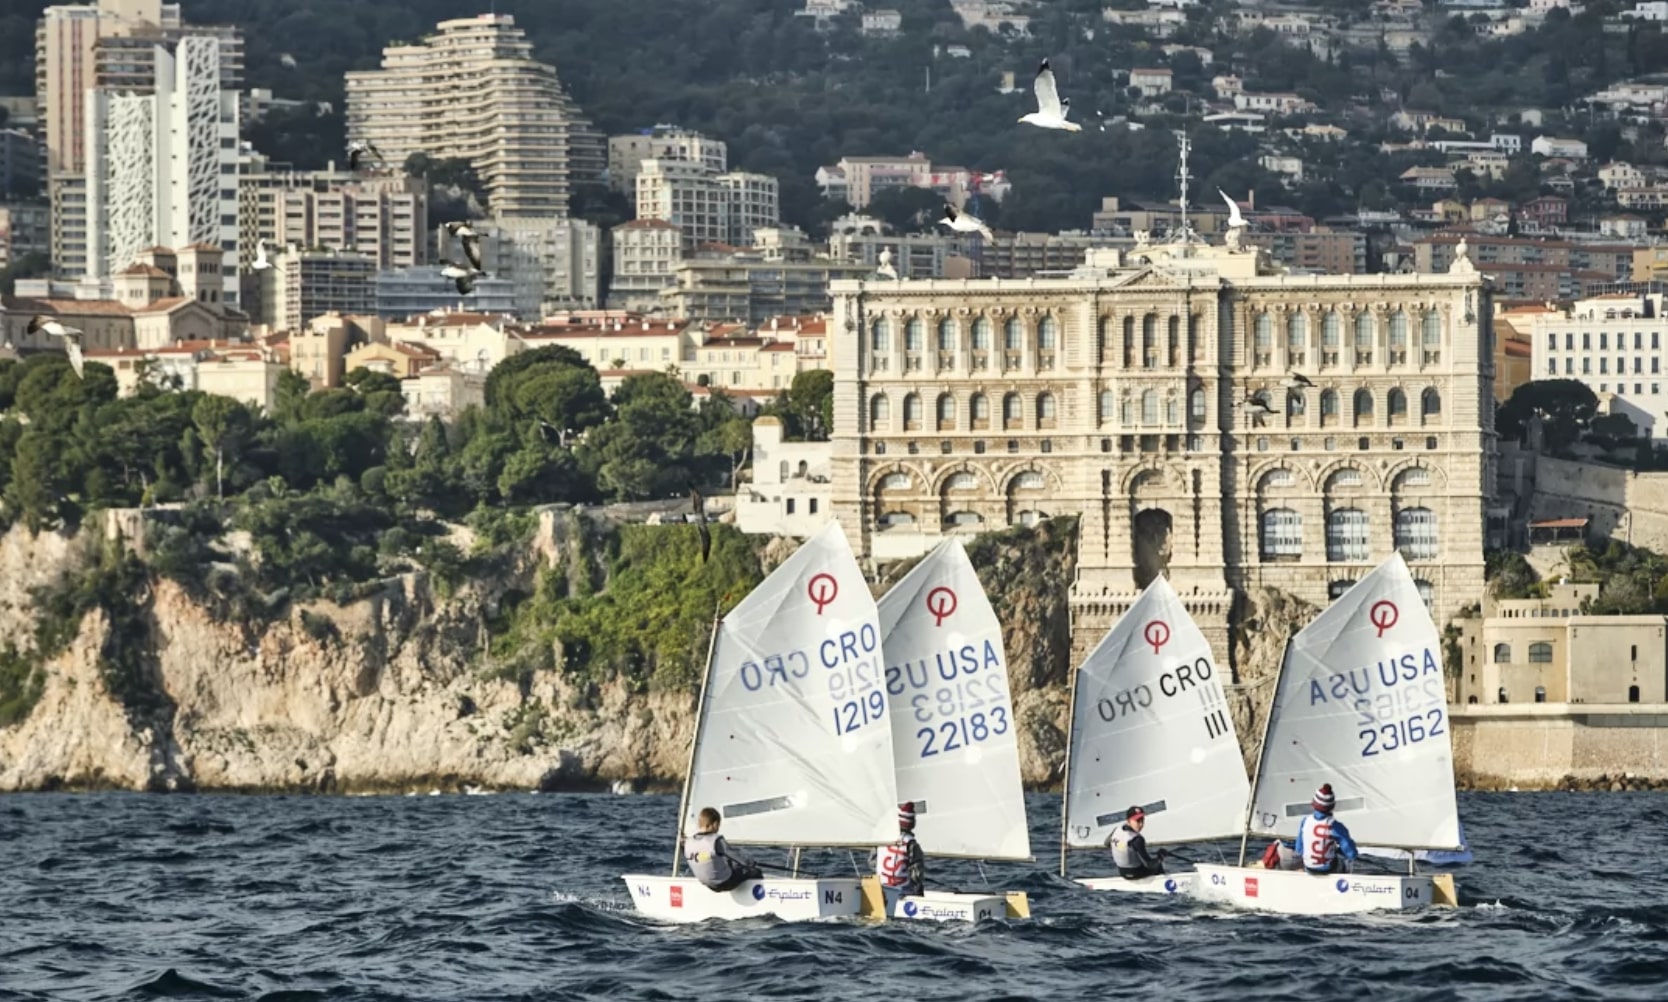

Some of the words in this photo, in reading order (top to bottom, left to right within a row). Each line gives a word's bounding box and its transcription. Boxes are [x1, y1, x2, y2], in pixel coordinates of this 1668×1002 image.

[820, 623, 876, 668] CRO
[936, 640, 999, 680] USA
[1159, 657, 1211, 697] CRO
[1378, 648, 1437, 687] USA
[833, 690, 885, 736] 1219
[917, 706, 1008, 758] 22183
[1359, 708, 1444, 757] 23162
[825, 890, 842, 904] N4
